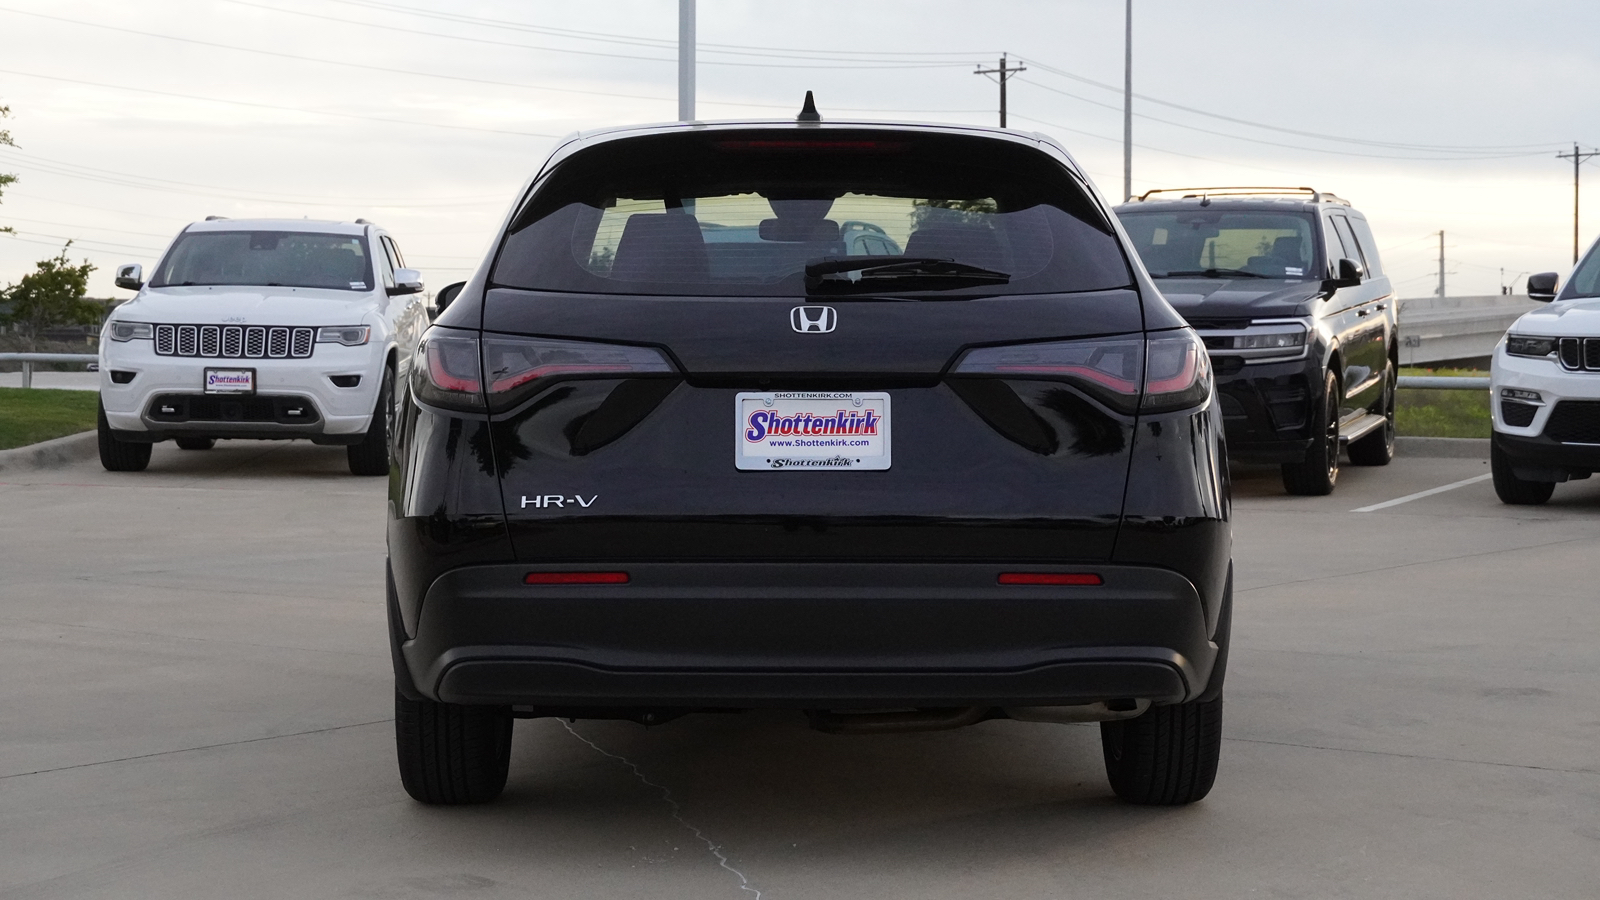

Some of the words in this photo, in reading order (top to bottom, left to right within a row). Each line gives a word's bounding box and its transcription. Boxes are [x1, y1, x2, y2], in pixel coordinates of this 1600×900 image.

[208, 375, 250, 385] Shottenkirk
[746, 410, 880, 443] Shottenkirk
[770, 439, 869, 447] www.Shottenkirk.com
[771, 457, 852, 468] Shottenkirk
[521, 495, 598, 508] HR-V
